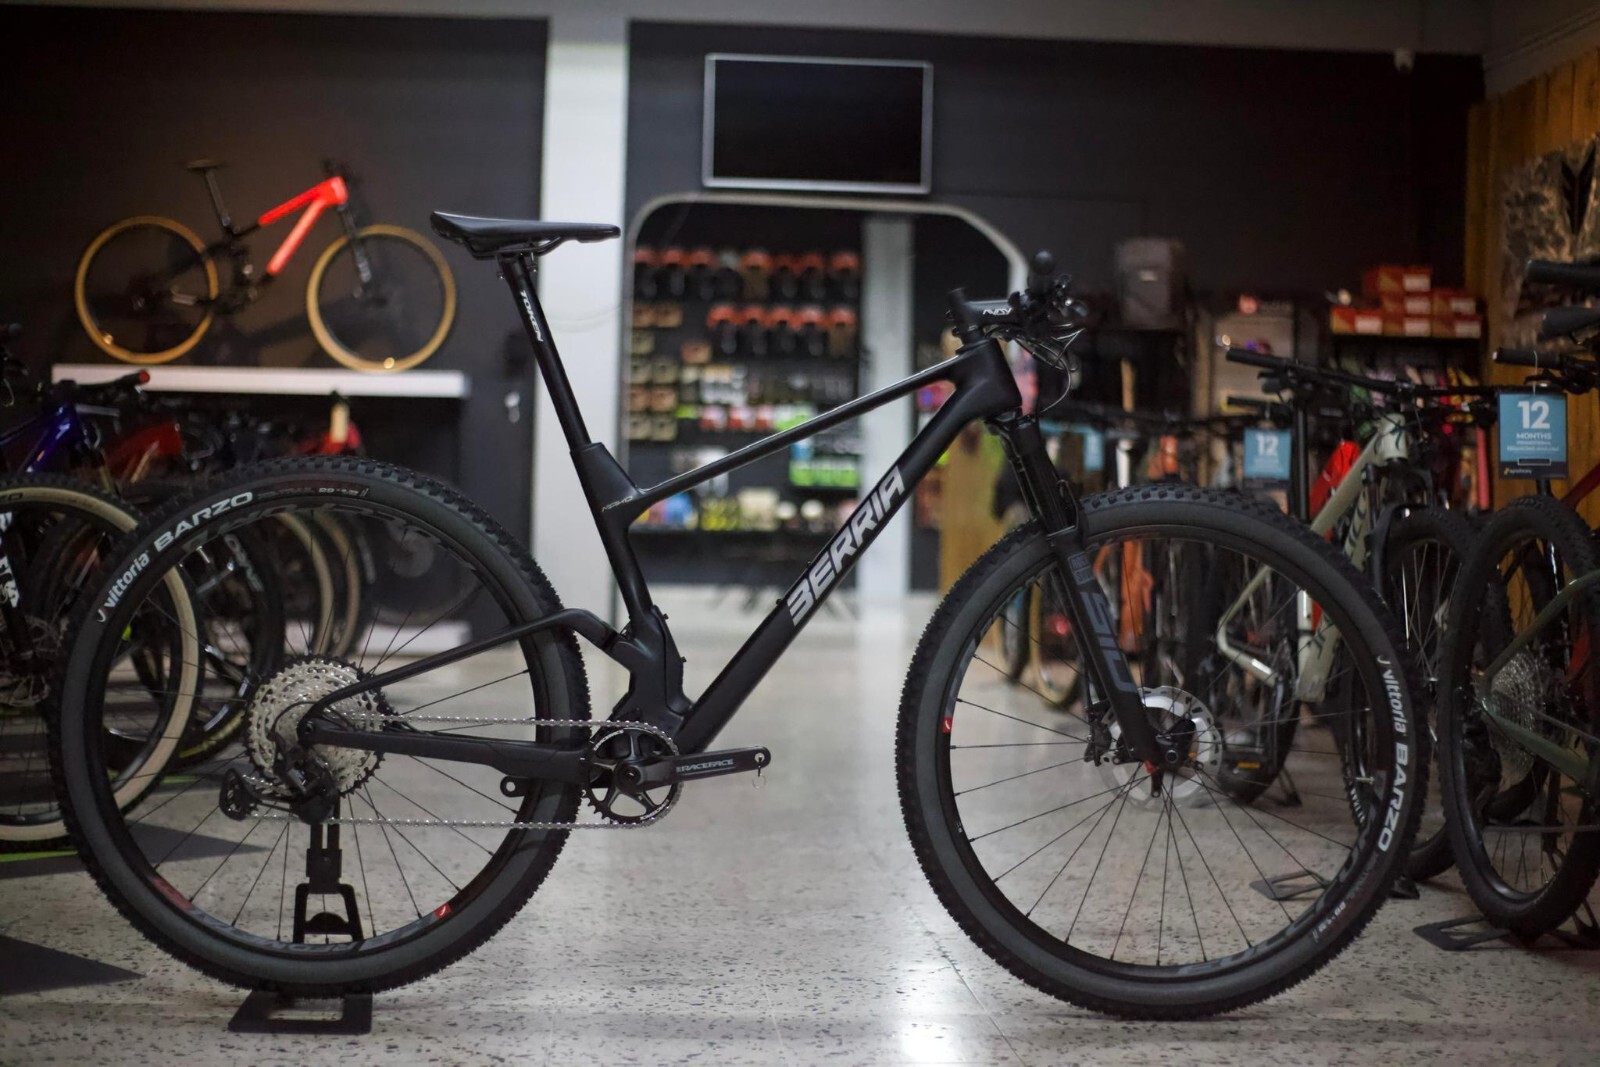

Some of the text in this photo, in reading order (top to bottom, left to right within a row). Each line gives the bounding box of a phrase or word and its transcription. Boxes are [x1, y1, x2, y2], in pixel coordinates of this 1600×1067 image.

[520, 289, 543, 342] TOKEN
[1516, 432, 1552, 440] MONTHS
[1517, 400, 1550, 429] 12
[1255, 433, 1278, 456] 12
[104, 492, 253, 608] vittoria BARZO
[787, 466, 905, 626] BERRIA
[1377, 669, 1409, 851] vittoria BARZO
